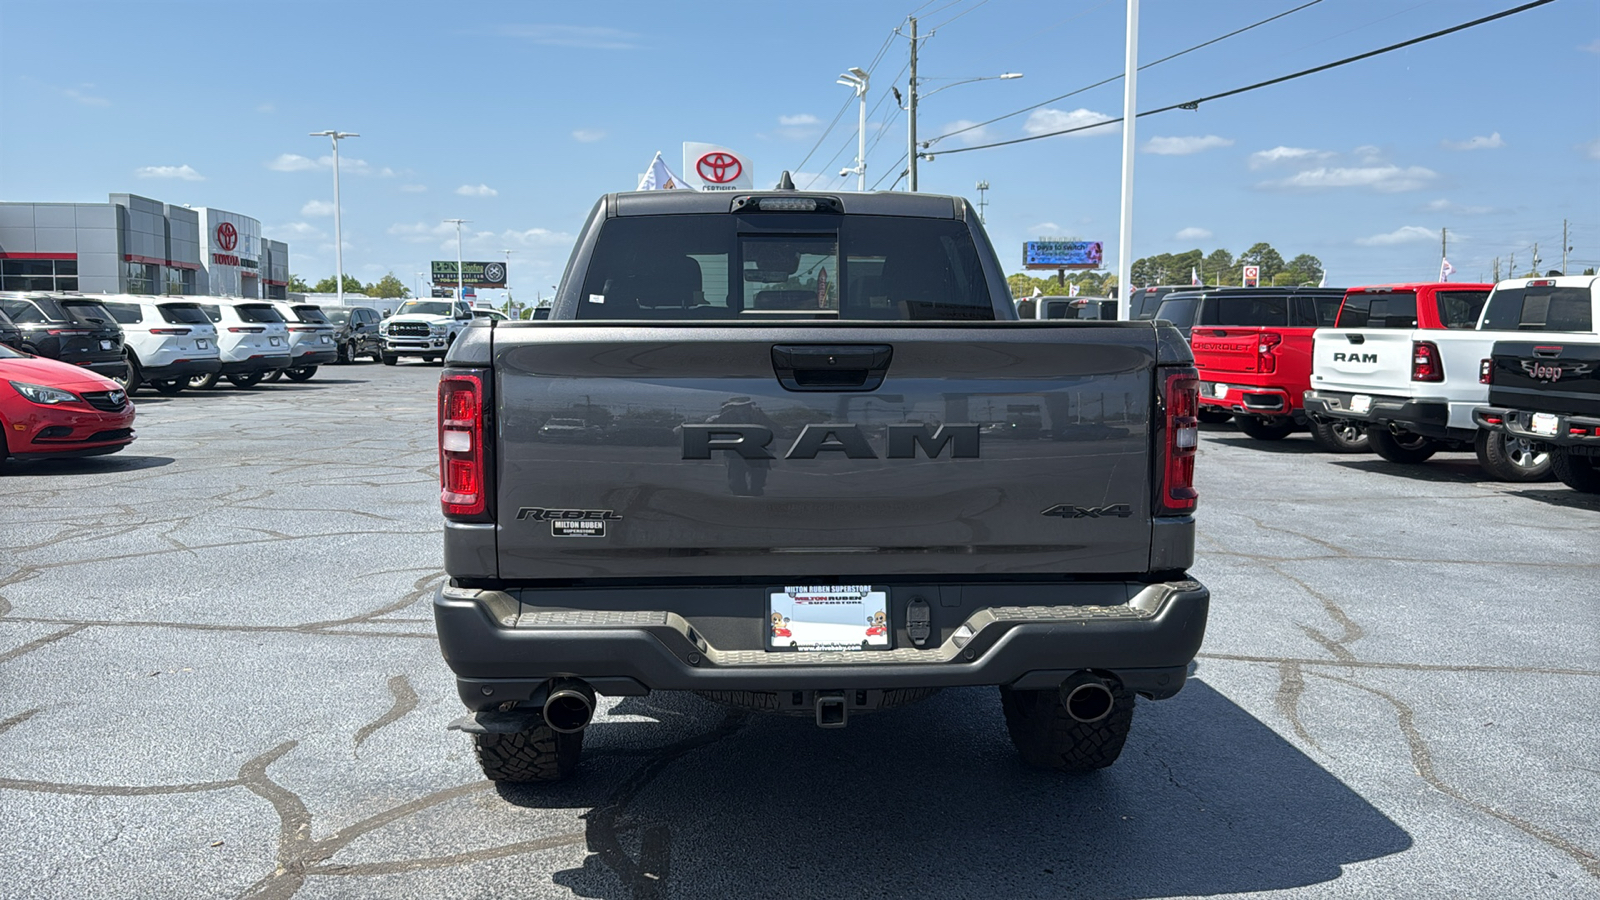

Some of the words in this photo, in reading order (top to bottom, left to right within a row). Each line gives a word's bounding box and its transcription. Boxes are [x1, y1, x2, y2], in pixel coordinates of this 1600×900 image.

[213, 253, 240, 267] TOYOTA
[1193, 343, 1251, 351] CHEVROLET
[1333, 352, 1378, 364] RAM
[1529, 362, 1562, 382] Jeep
[681, 423, 980, 460] RAM
[515, 506, 623, 522] REBEL
[1040, 503, 1134, 519] 4x4
[555, 521, 580, 529] MILTON
[580, 521, 602, 529] RUBEN
[809, 585, 829, 593] RUBEN
[831, 585, 872, 593] SUPERSTORE
